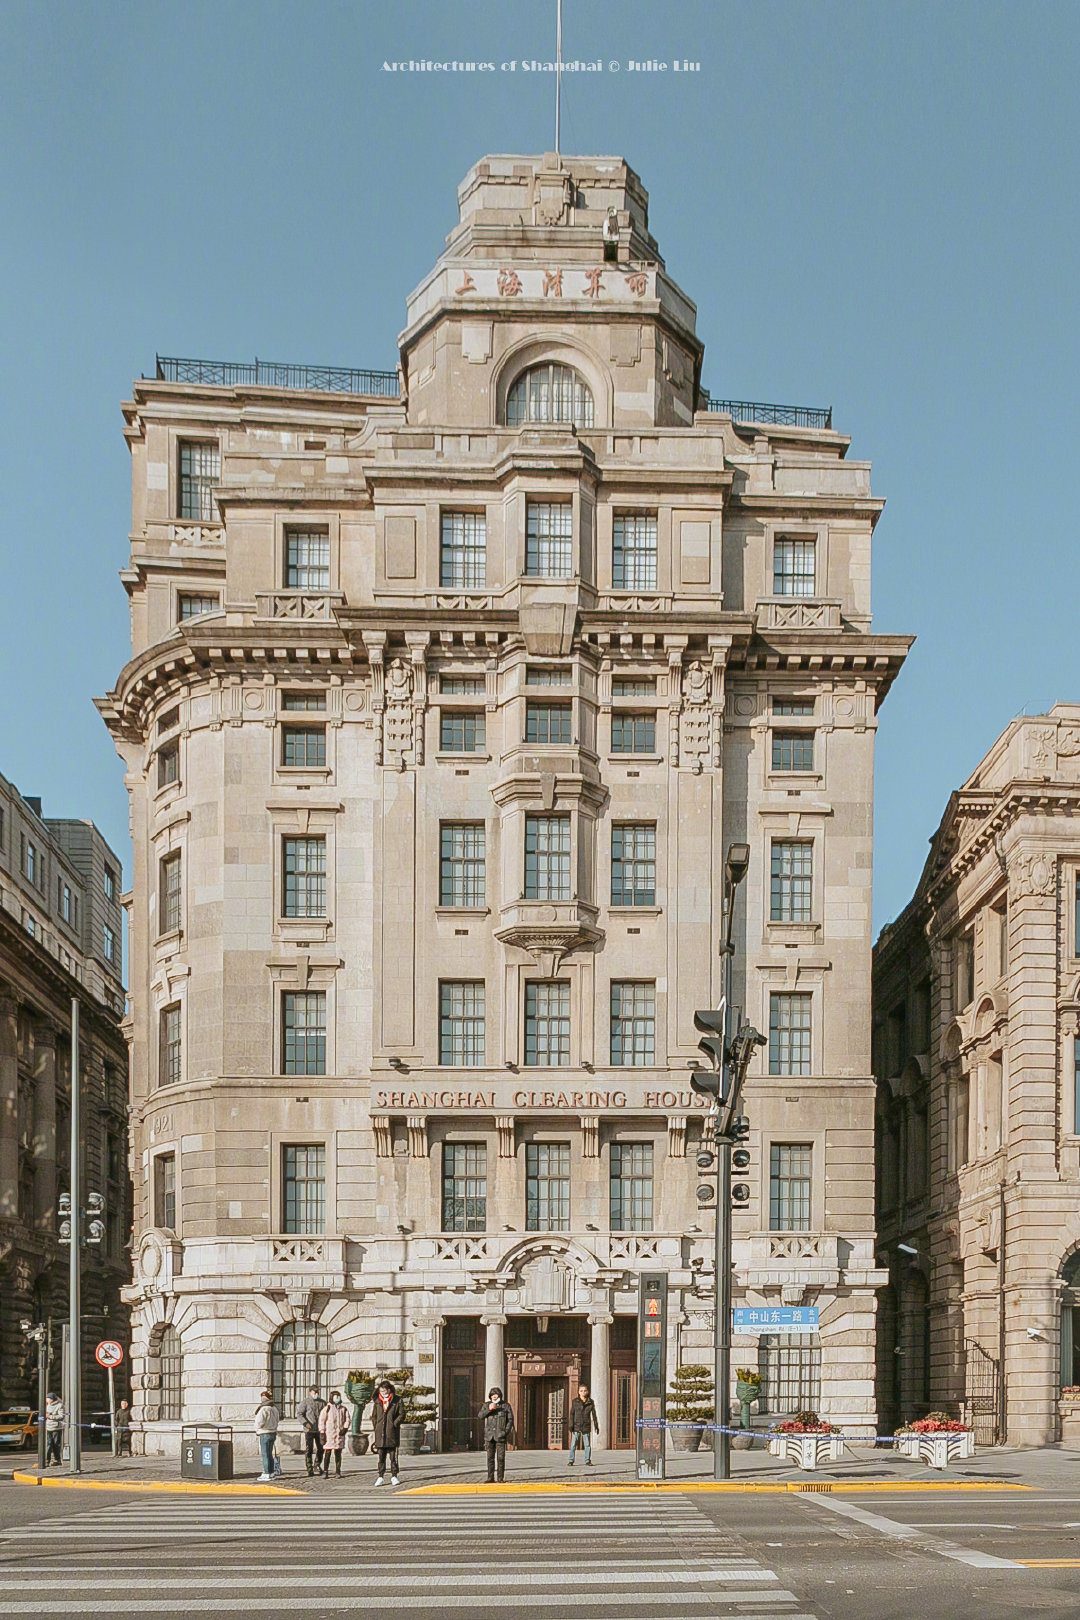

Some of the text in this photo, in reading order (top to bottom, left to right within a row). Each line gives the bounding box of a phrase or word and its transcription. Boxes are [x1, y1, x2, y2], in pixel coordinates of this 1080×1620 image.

[455, 267, 649, 298] 上海清算所
[376, 1091, 497, 1108] SHANGHAI
[512, 1091, 627, 1108] CLEARING
[152, 1113, 174, 1136] 1921
[749, 1310, 802, 1323] 中山东一路
